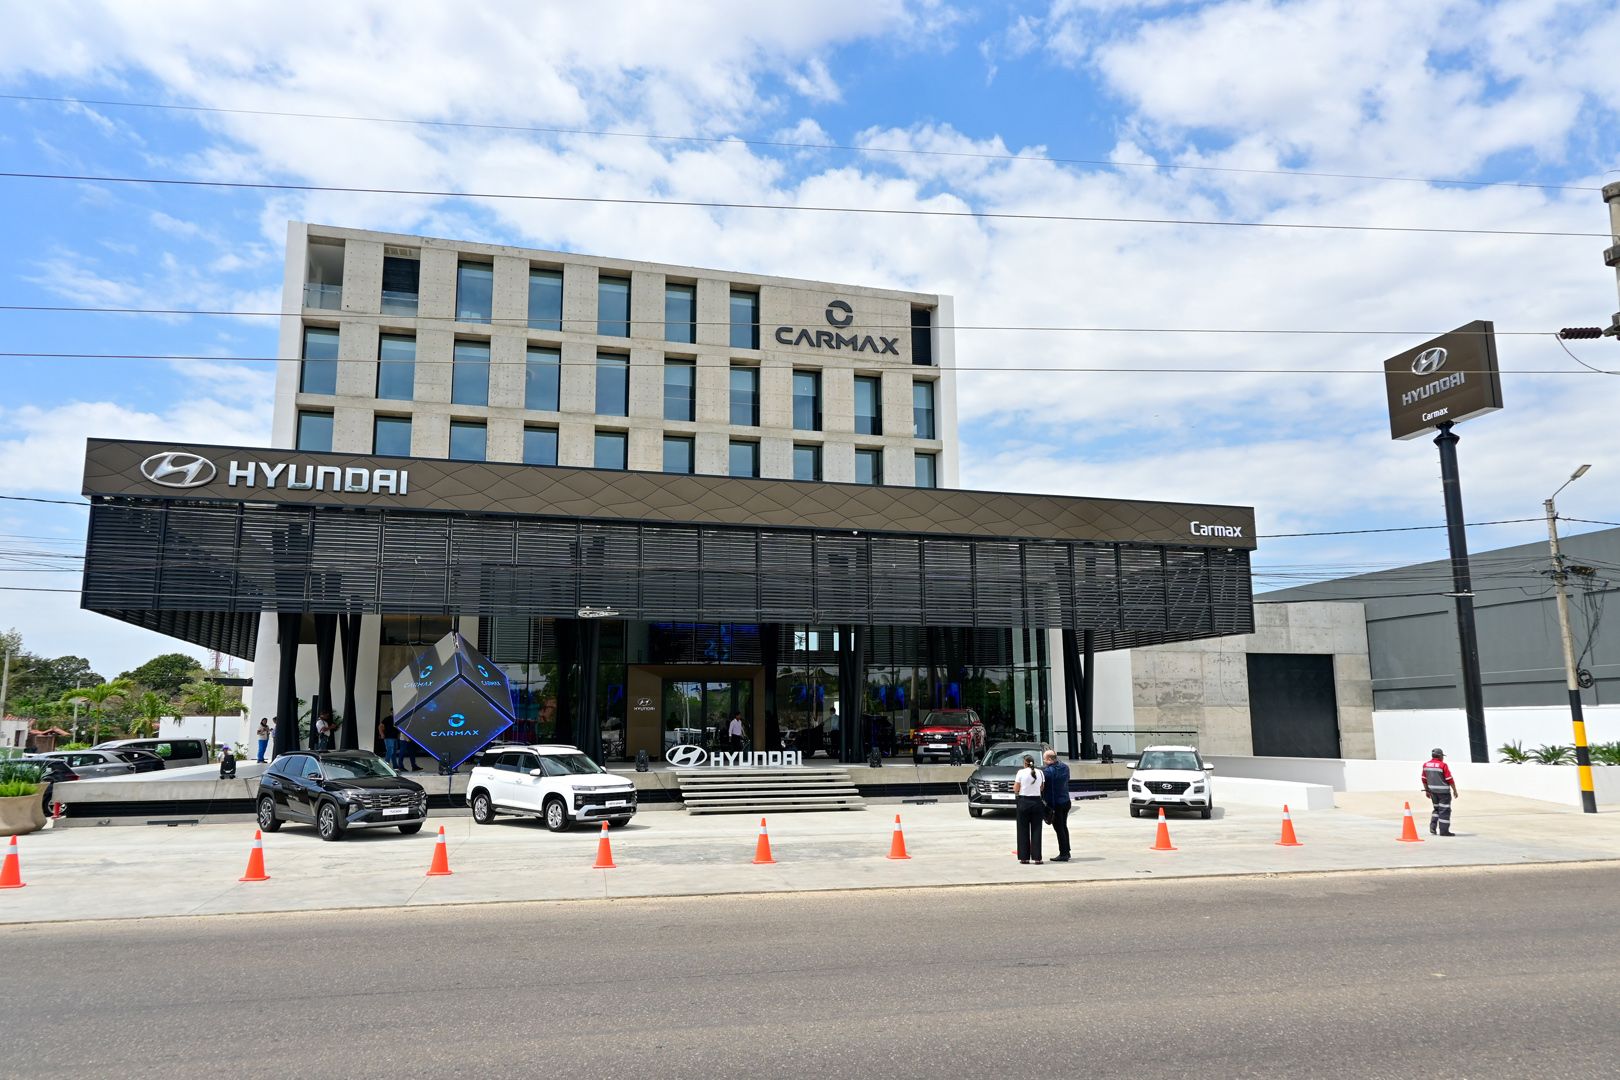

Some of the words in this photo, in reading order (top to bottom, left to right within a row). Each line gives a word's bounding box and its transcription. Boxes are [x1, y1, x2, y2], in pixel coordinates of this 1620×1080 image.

[775, 326, 899, 356] CARMAX
[1402, 371, 1466, 406] HYUNDAI
[1422, 407, 1449, 422] Carmax
[228, 460, 409, 496] HYUNDAI
[1190, 521, 1243, 538] Carmax
[430, 730, 480, 738] CARMAX
[710, 750, 803, 768] HYUNDAI
